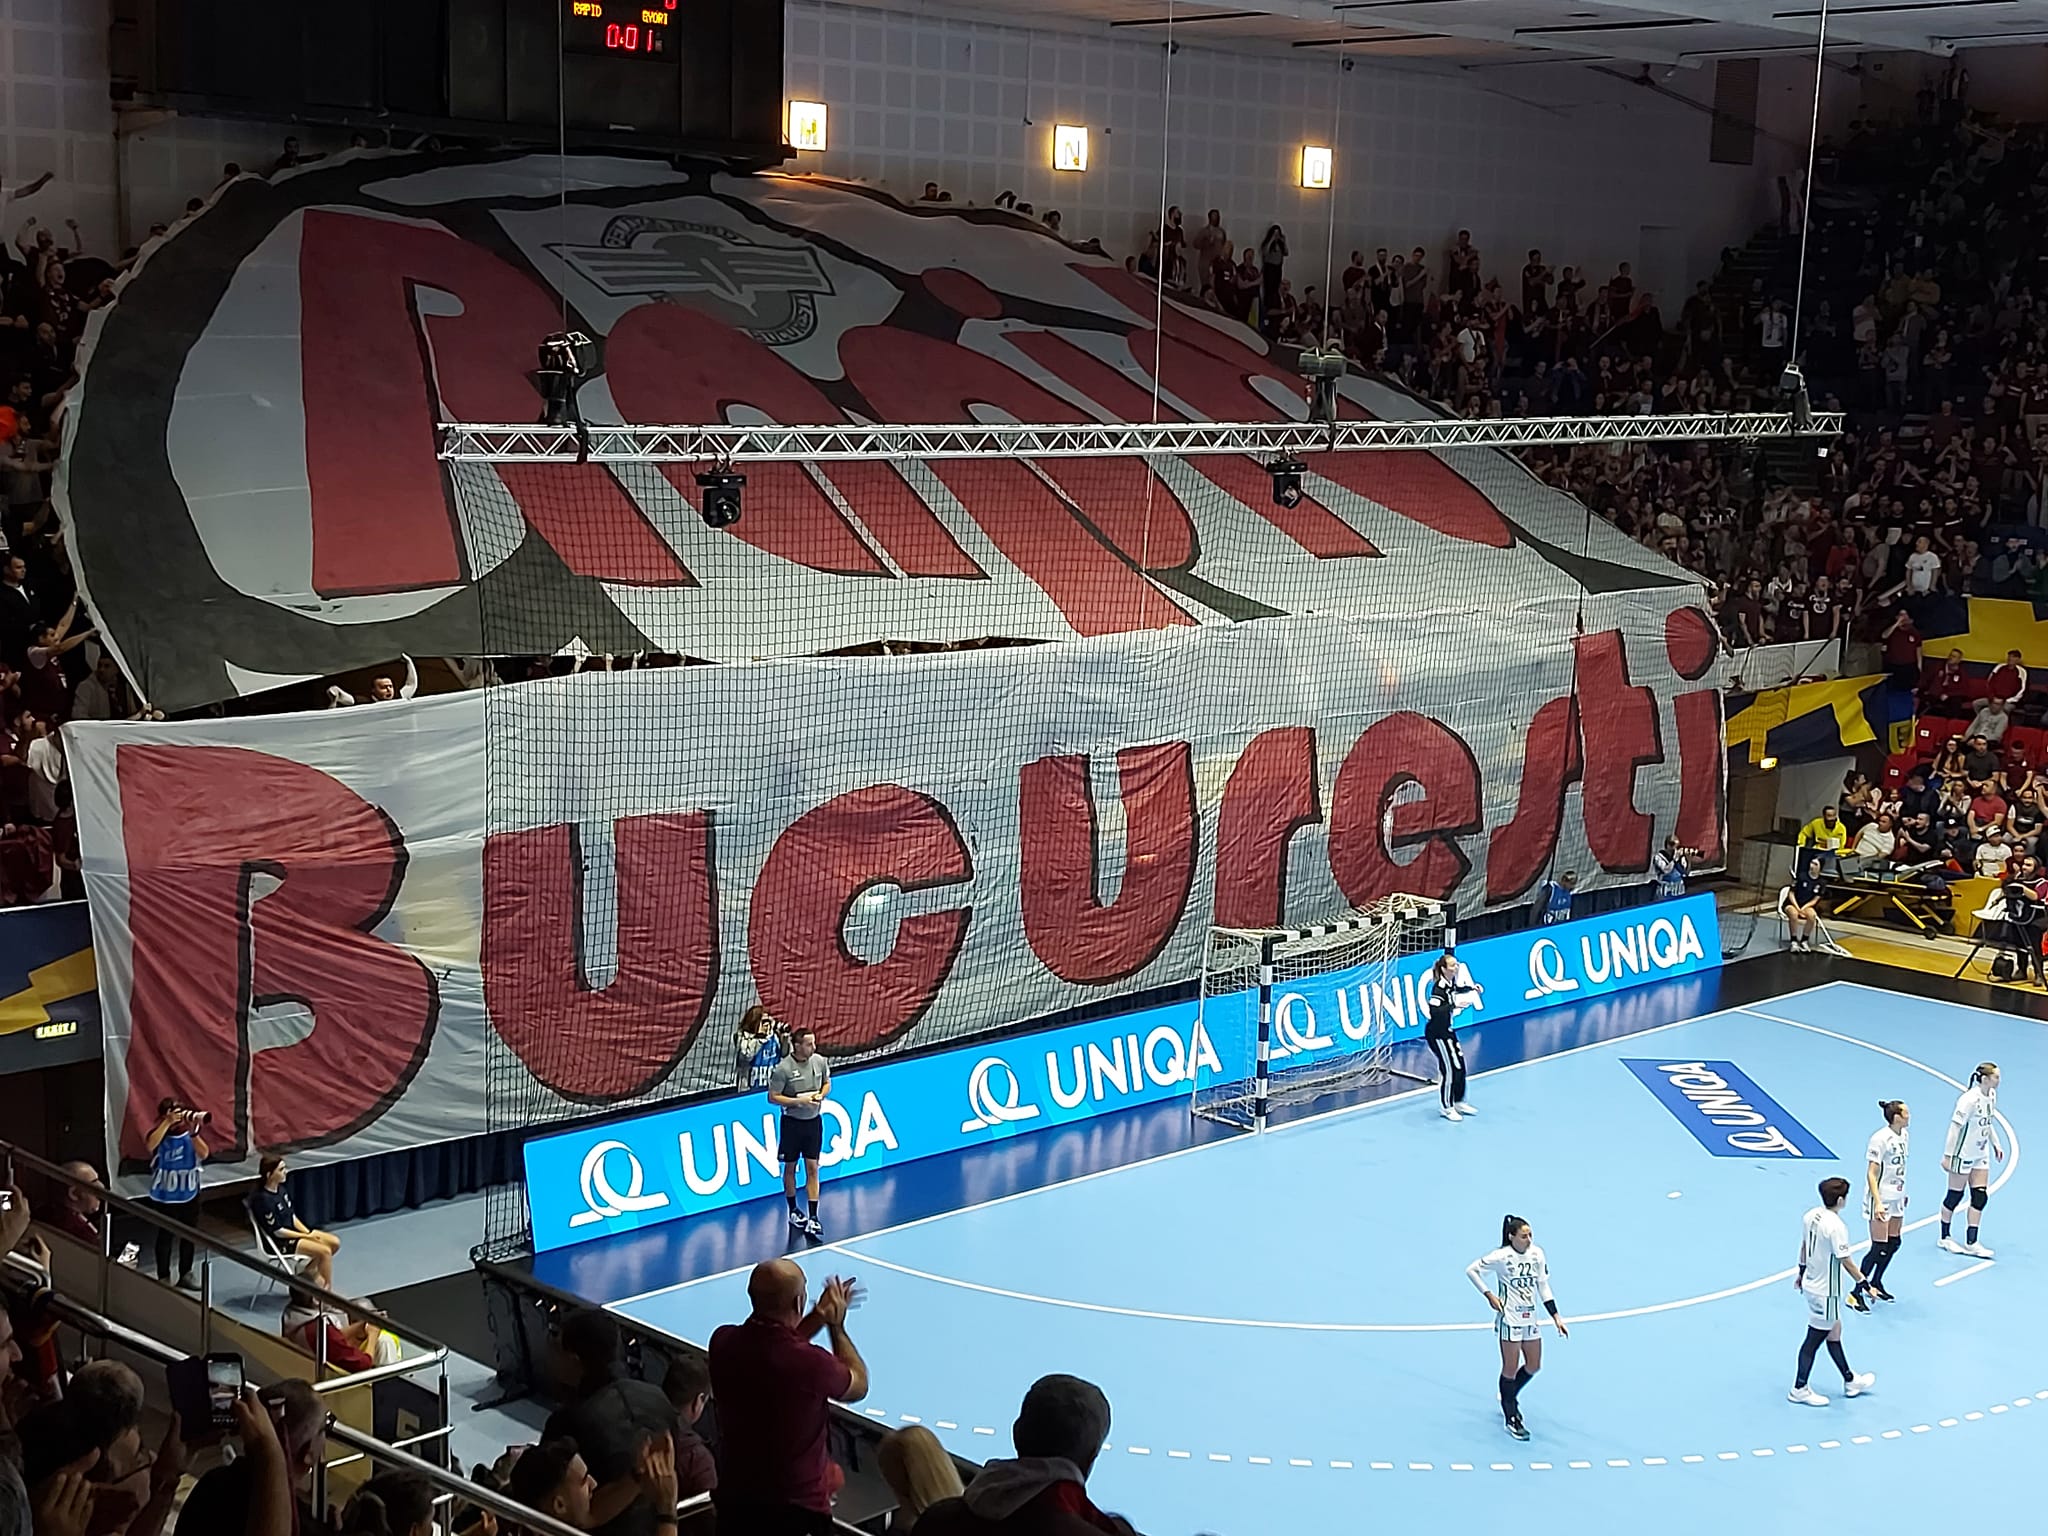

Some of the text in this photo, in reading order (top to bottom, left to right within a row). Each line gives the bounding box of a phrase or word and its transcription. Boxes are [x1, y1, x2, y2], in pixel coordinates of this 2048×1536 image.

[573, 2, 602, 18] RAPID
[1064, 139, 1081, 167] N
[1581, 914, 1705, 984] UNIQA
[1046, 1019, 1223, 1109] UNIQA
[1656, 1062, 1767, 1127] UNIQA
[678, 1090, 899, 1196] UNQA
[1517, 1262, 1533, 1277] 22
